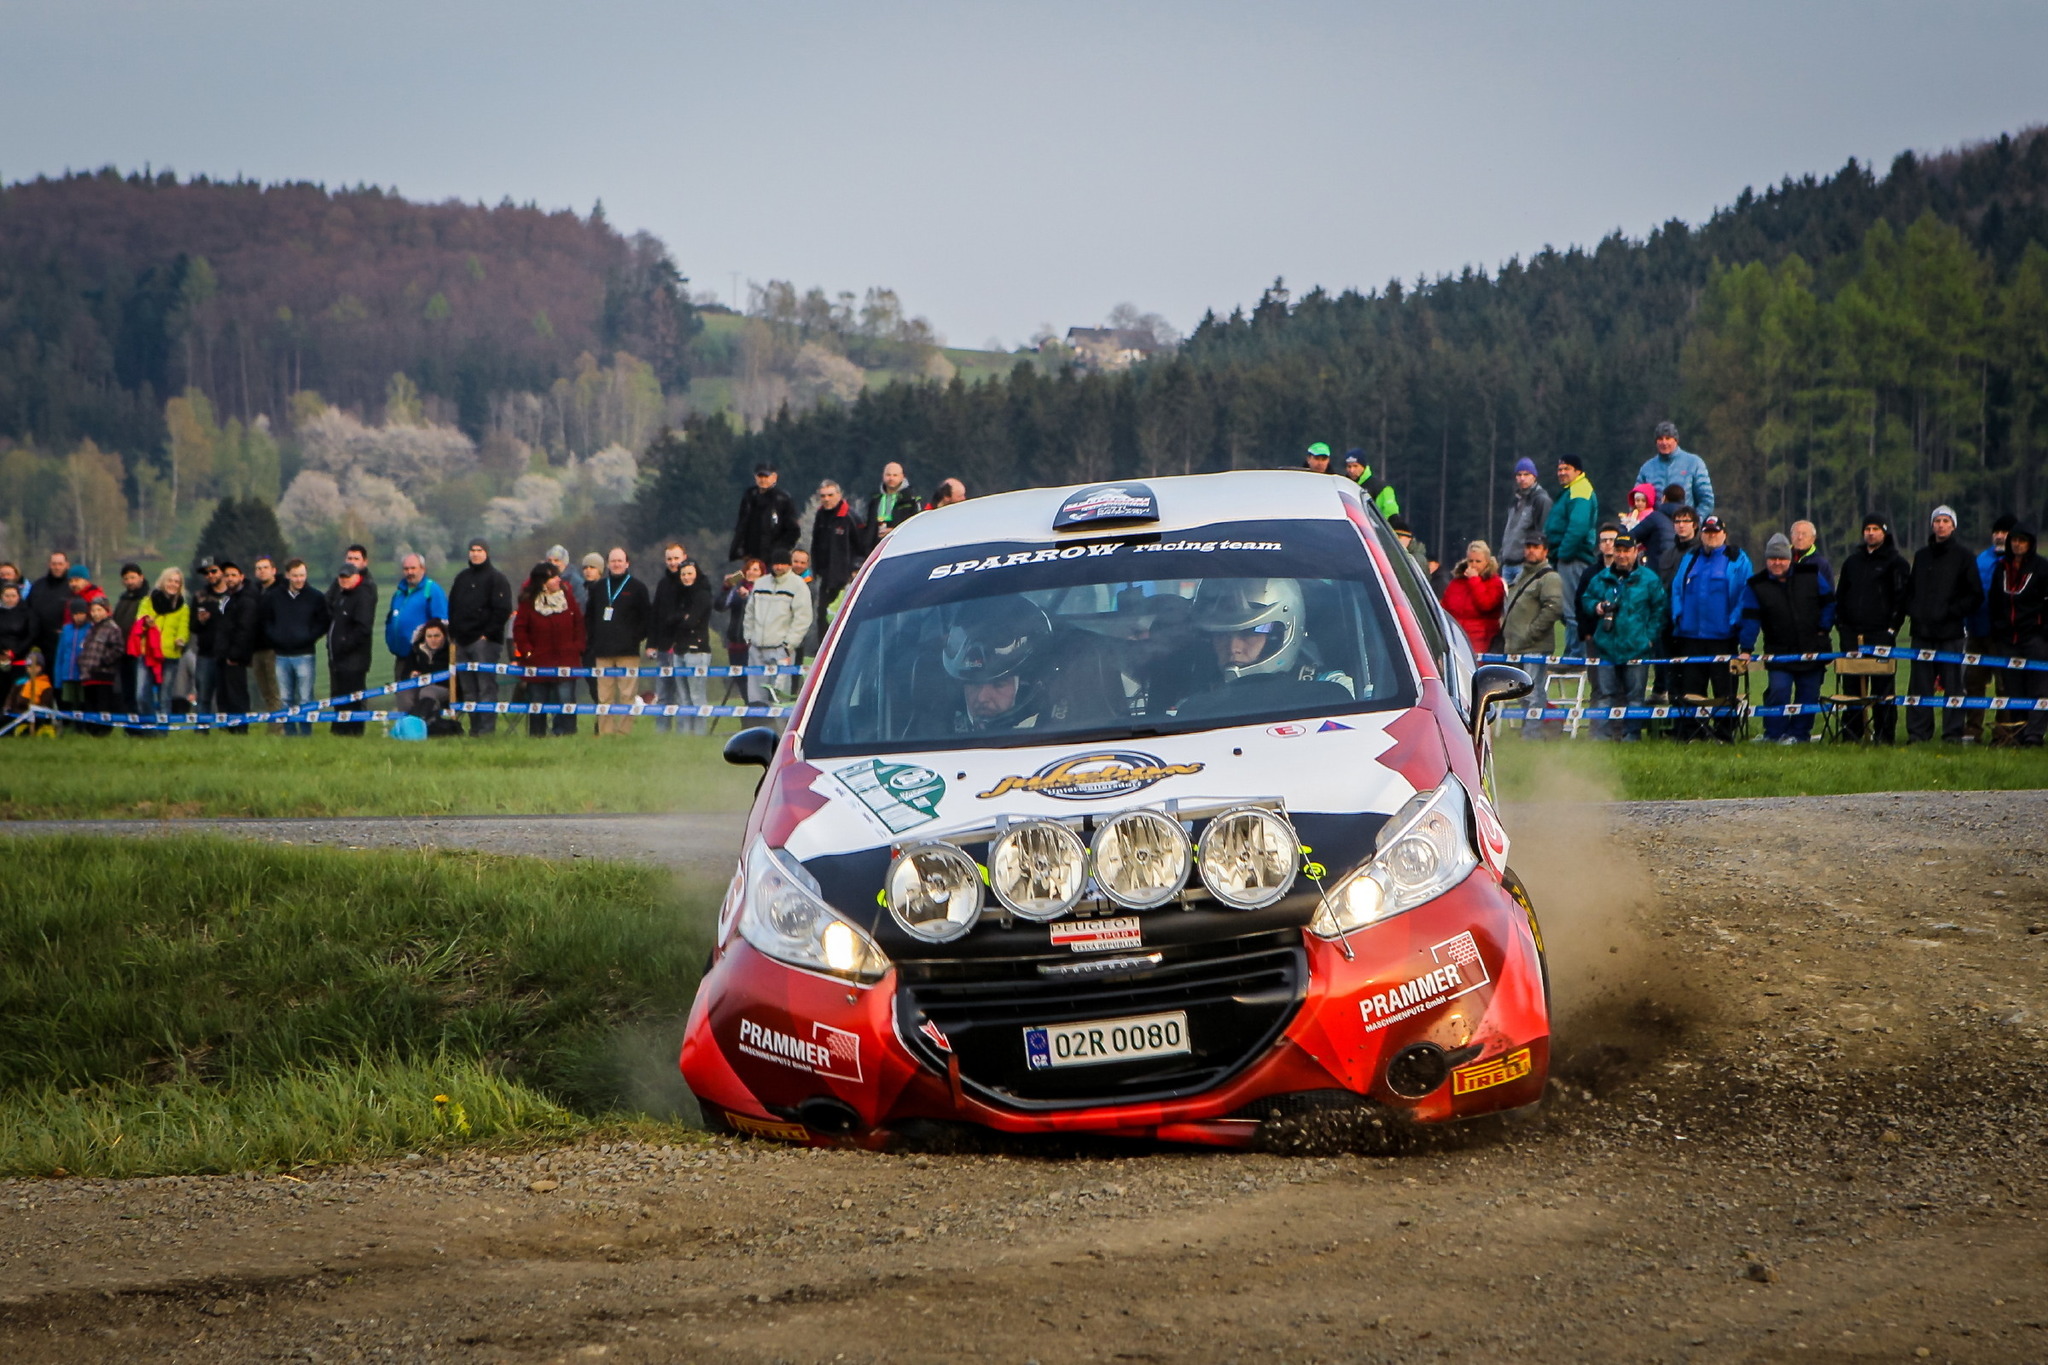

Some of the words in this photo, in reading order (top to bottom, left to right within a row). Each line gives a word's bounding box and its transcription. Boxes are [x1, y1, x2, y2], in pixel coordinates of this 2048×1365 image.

[927, 542, 1125, 581] SPARROW
[1133, 541, 1218, 553] racing
[1219, 540, 1283, 551] team
[1051, 917, 1138, 934] PEUGEOT
[1095, 929, 1139, 940] SPORT
[1359, 963, 1463, 1023] PRAMMER
[1365, 1003, 1427, 1033] MASCHINENPUTZ
[1425, 994, 1447, 1010] GmbH
[739, 1017, 832, 1069] PRAMMER
[1055, 1031, 1109, 1059] 02R
[1112, 1020, 1181, 1054] 0080
[1456, 1052, 1530, 1093] PIRELLI
